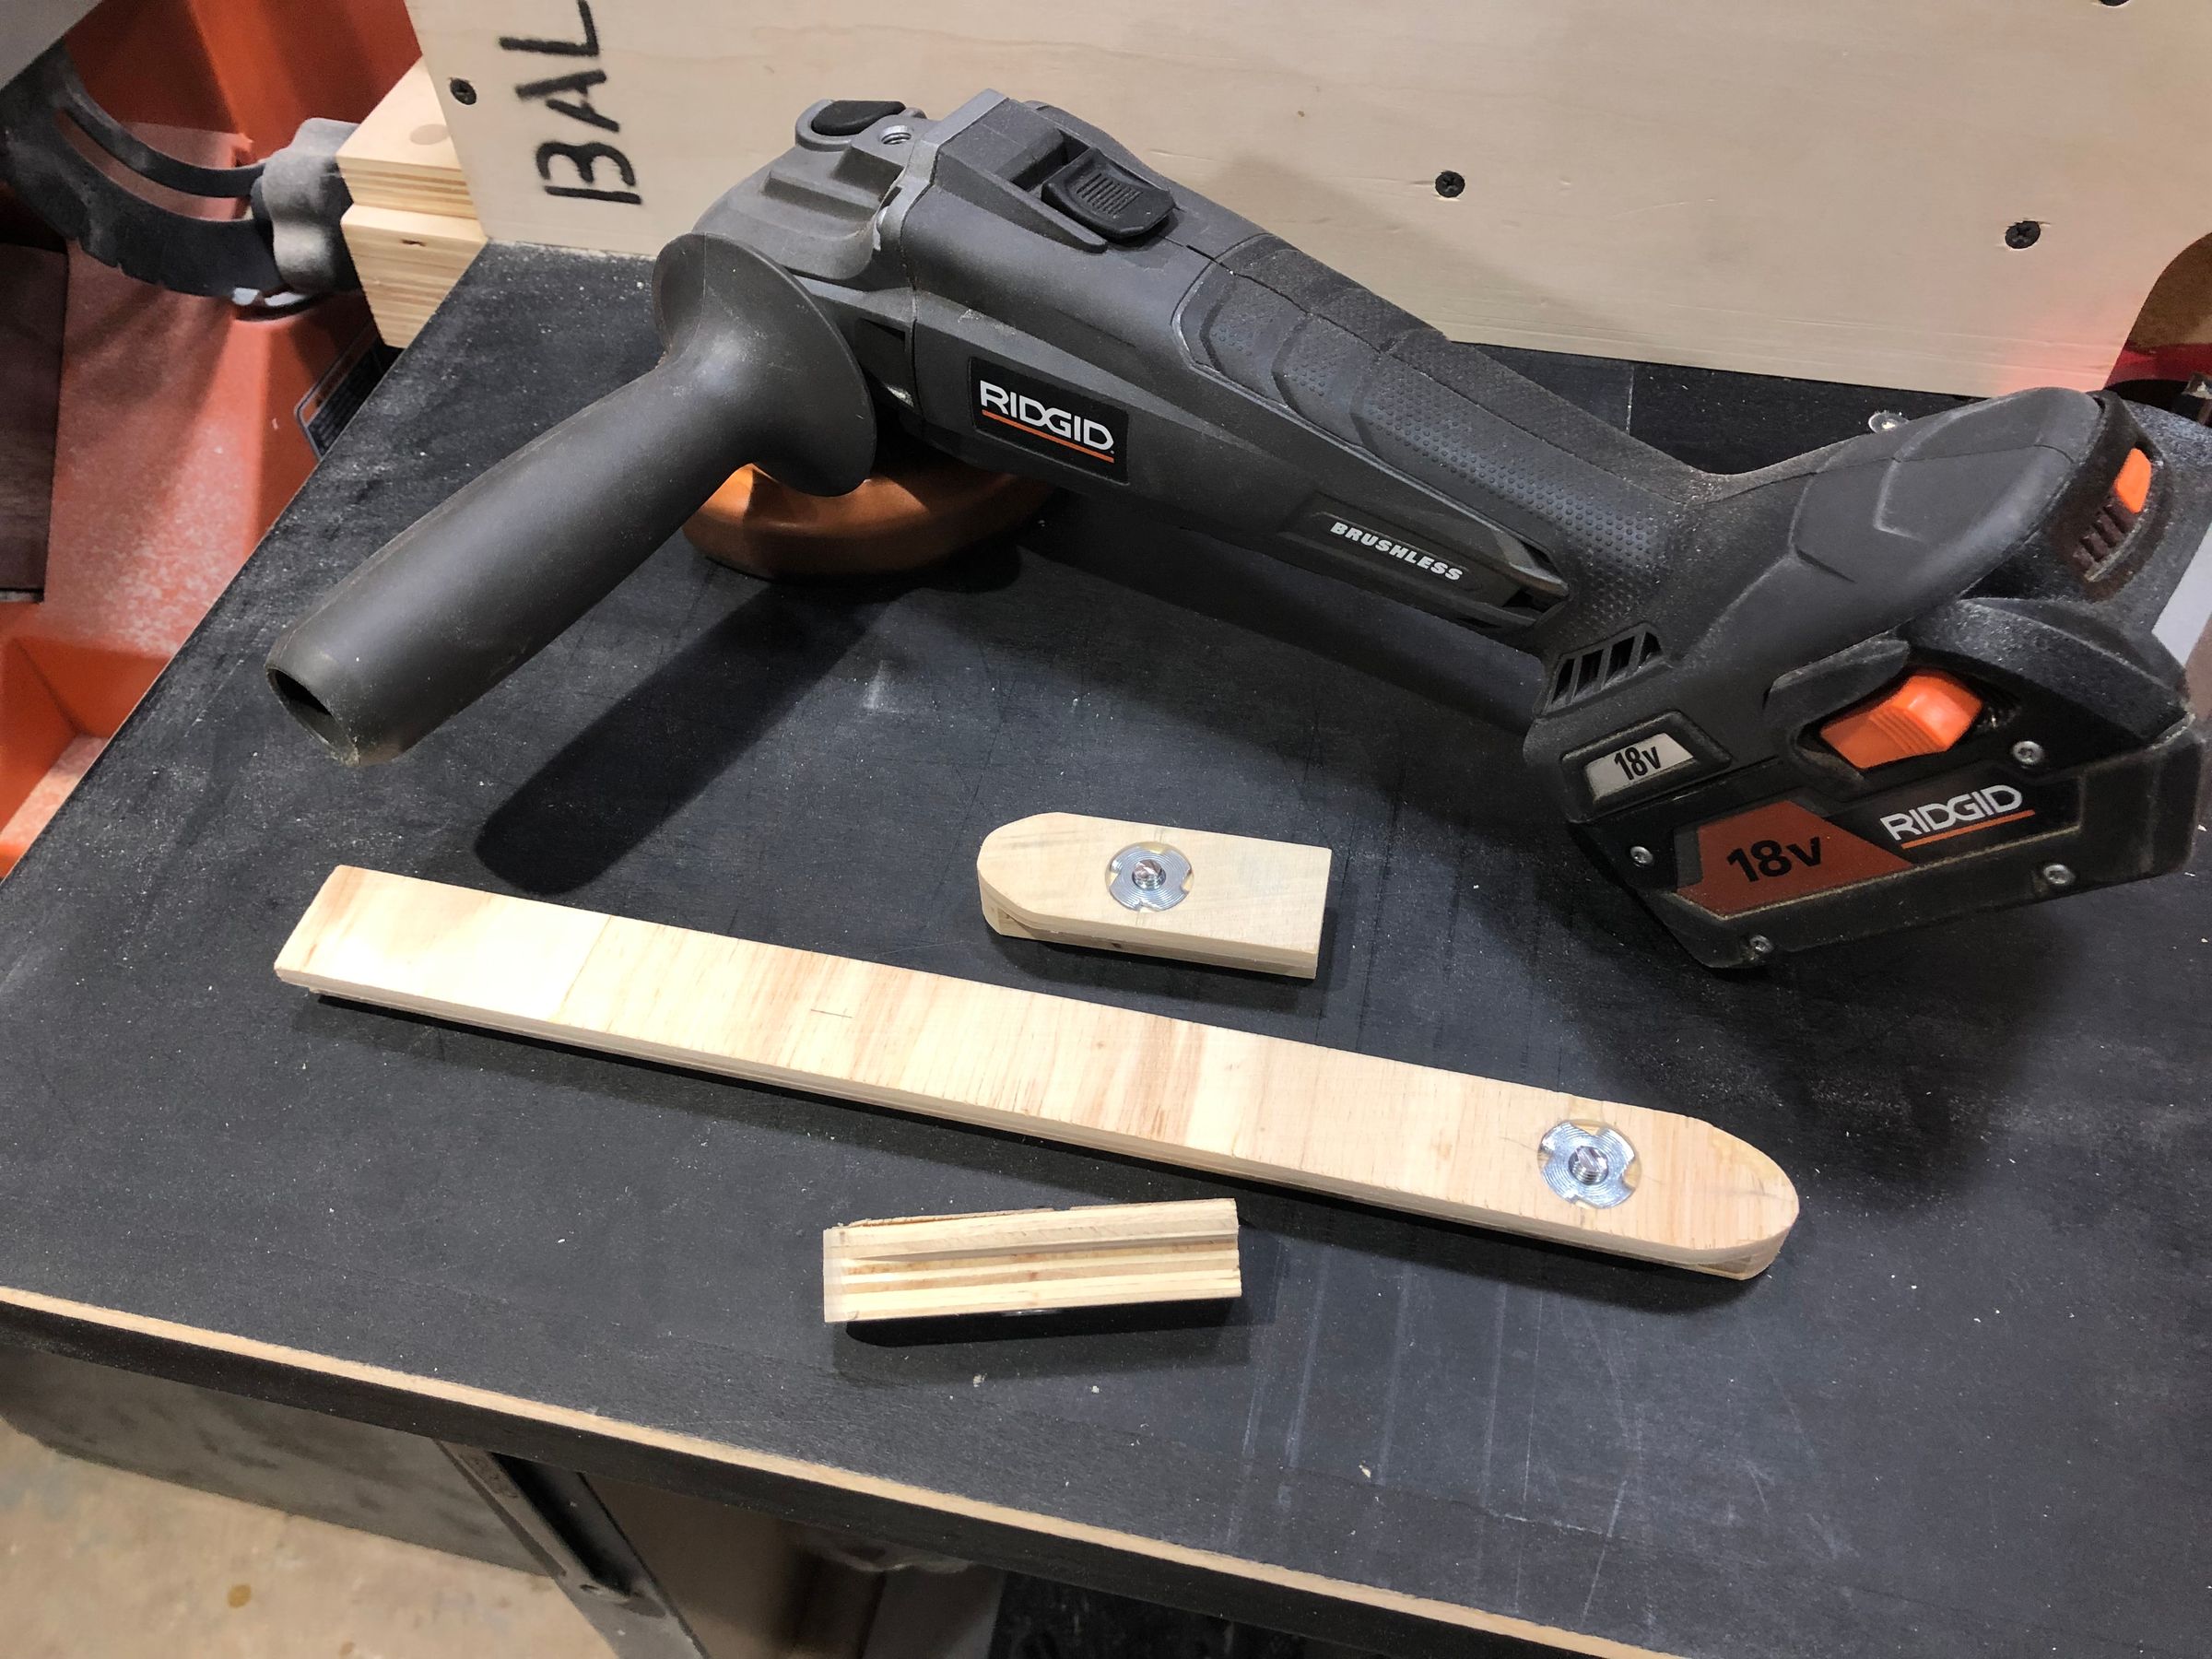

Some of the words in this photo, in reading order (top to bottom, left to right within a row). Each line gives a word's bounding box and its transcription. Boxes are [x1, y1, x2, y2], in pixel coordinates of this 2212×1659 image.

[499, 0, 642, 205] BAL
[980, 380, 1114, 451] RIDGID
[1330, 522, 1464, 581] BRUSHLESS
[1880, 784, 2023, 841] RIDGID
